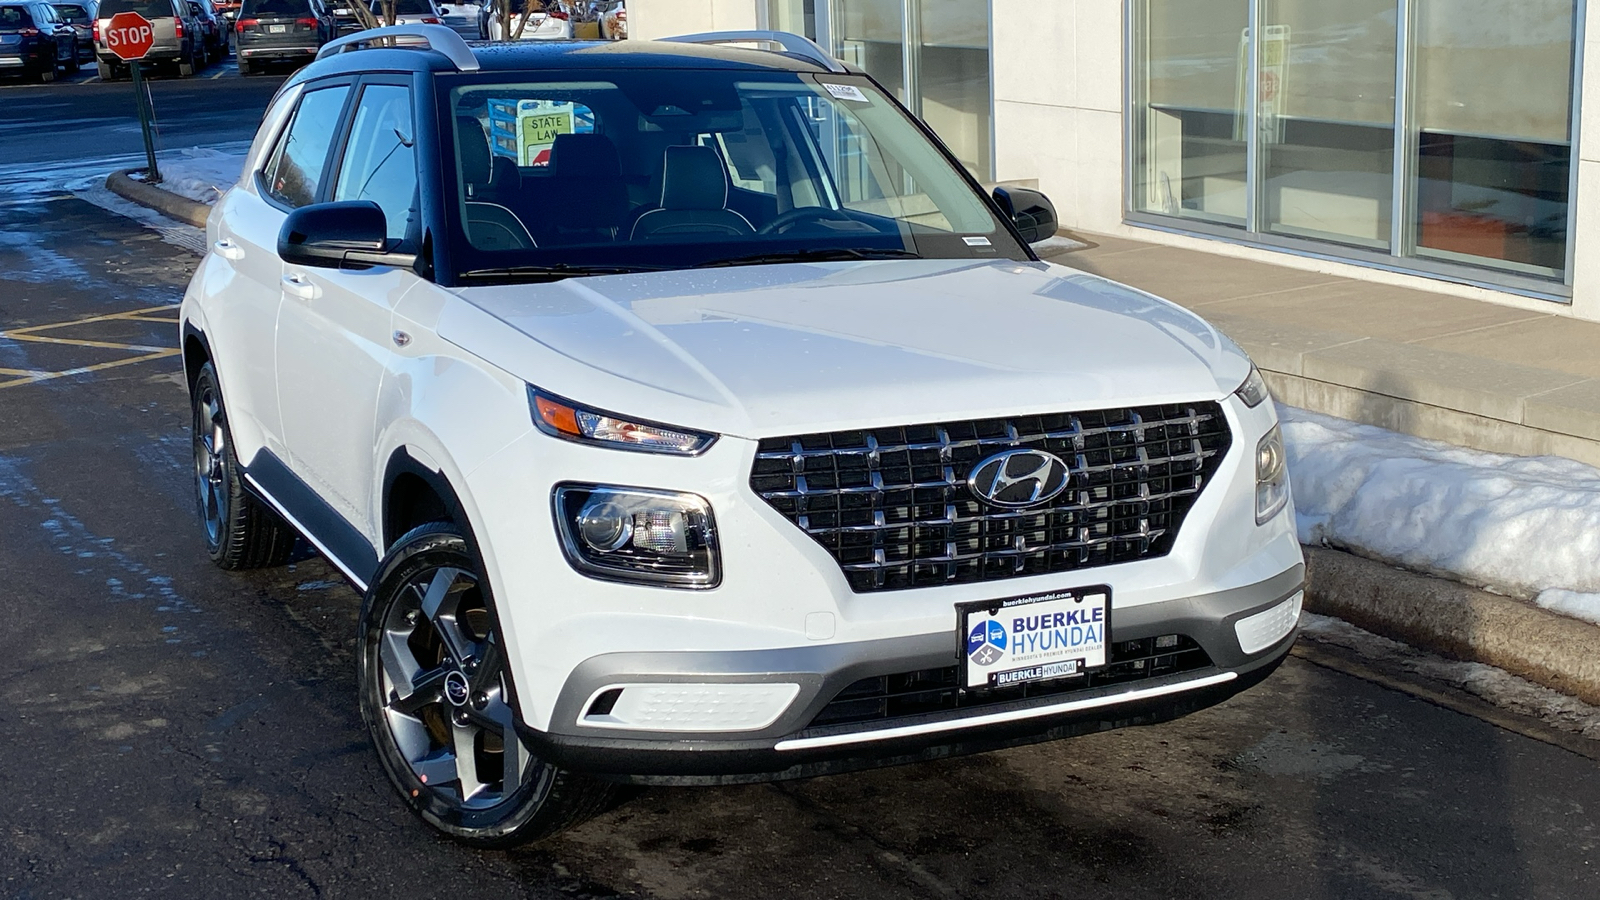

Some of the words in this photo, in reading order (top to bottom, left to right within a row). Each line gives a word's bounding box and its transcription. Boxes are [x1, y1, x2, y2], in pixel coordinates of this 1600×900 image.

[108, 25, 150, 46] STOP
[532, 116, 562, 129] STATE
[537, 129, 558, 141] LAW
[1002, 592, 1072, 607] buerklehyundai.com
[1012, 607, 1103, 633] BUERKLE
[1012, 623, 1102, 655] HYUNDAI
[1085, 644, 1103, 652] DEALER
[999, 667, 1042, 684] BUERKLE
[1043, 663, 1075, 676] HYUNDAI
